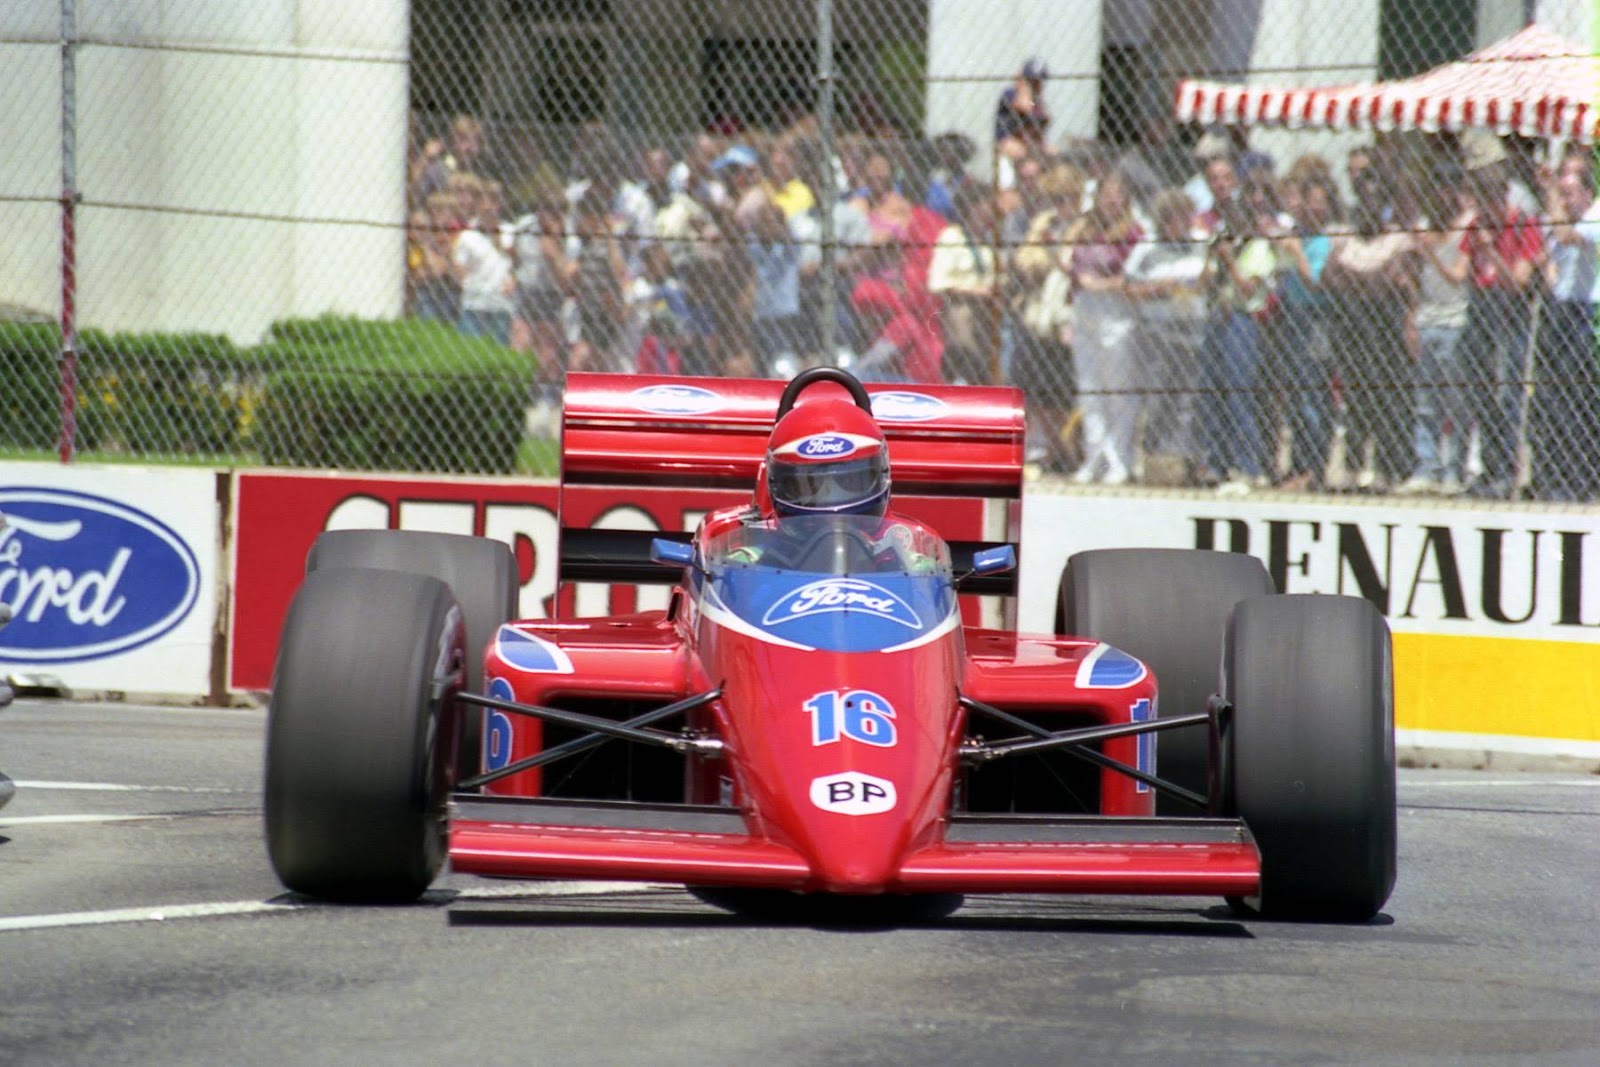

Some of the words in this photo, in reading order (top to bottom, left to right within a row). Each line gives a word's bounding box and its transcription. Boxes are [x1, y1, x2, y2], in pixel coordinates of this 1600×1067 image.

[806, 437, 845, 454] Ford
[790, 583, 895, 613] Ford
[802, 689, 898, 748] 16
[827, 780, 887, 803] BP
